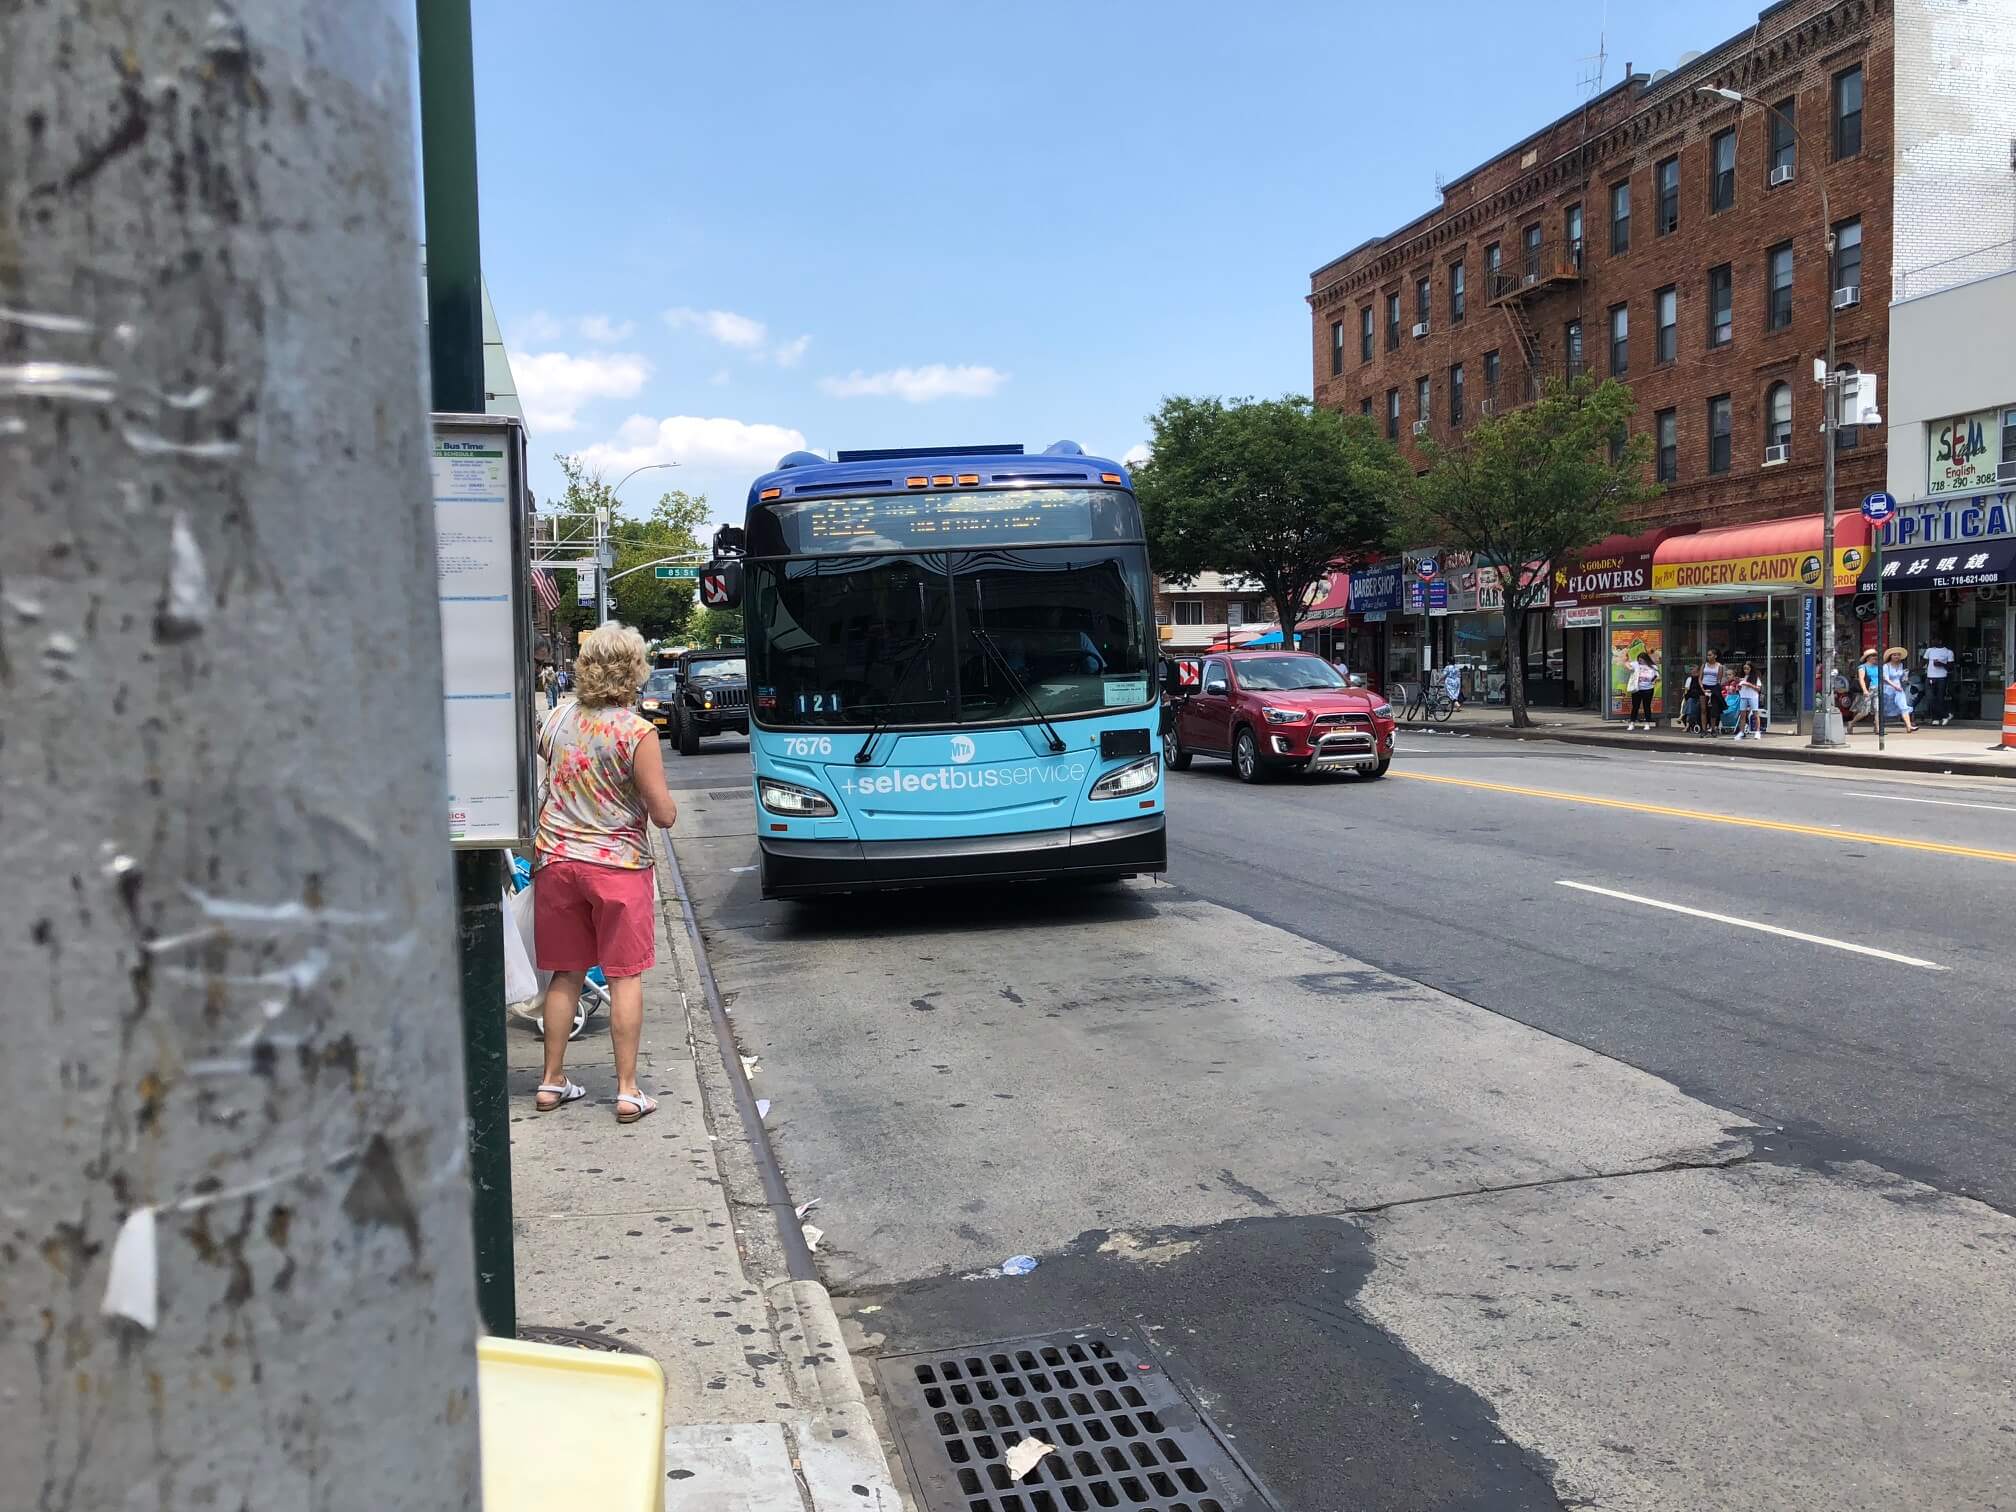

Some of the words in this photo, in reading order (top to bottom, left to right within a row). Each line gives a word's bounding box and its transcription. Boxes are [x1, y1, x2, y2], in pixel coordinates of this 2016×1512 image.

[443, 442, 460, 450] Bus
[461, 442, 484, 450] Time
[1945, 464, 1976, 479] English
[1931, 480, 1945, 492] 718
[1952, 477, 1968, 489] 290
[1975, 472, 1996, 485] 3082
[1881, 505, 2016, 546] PTICA
[1586, 559, 1618, 572] GOLDEN
[1677, 564, 1737, 586] GROCERY
[1738, 567, 1747, 582] &
[1750, 557, 1799, 581] CANDY
[1354, 577, 1377, 598] BARBER
[1378, 575, 1395, 596] SHOP
[1568, 568, 1644, 593] FLOWERS
[1833, 573, 1859, 586] GROC
[1933, 577, 1950, 587] TEL:
[783, 736, 832, 755] 7676
